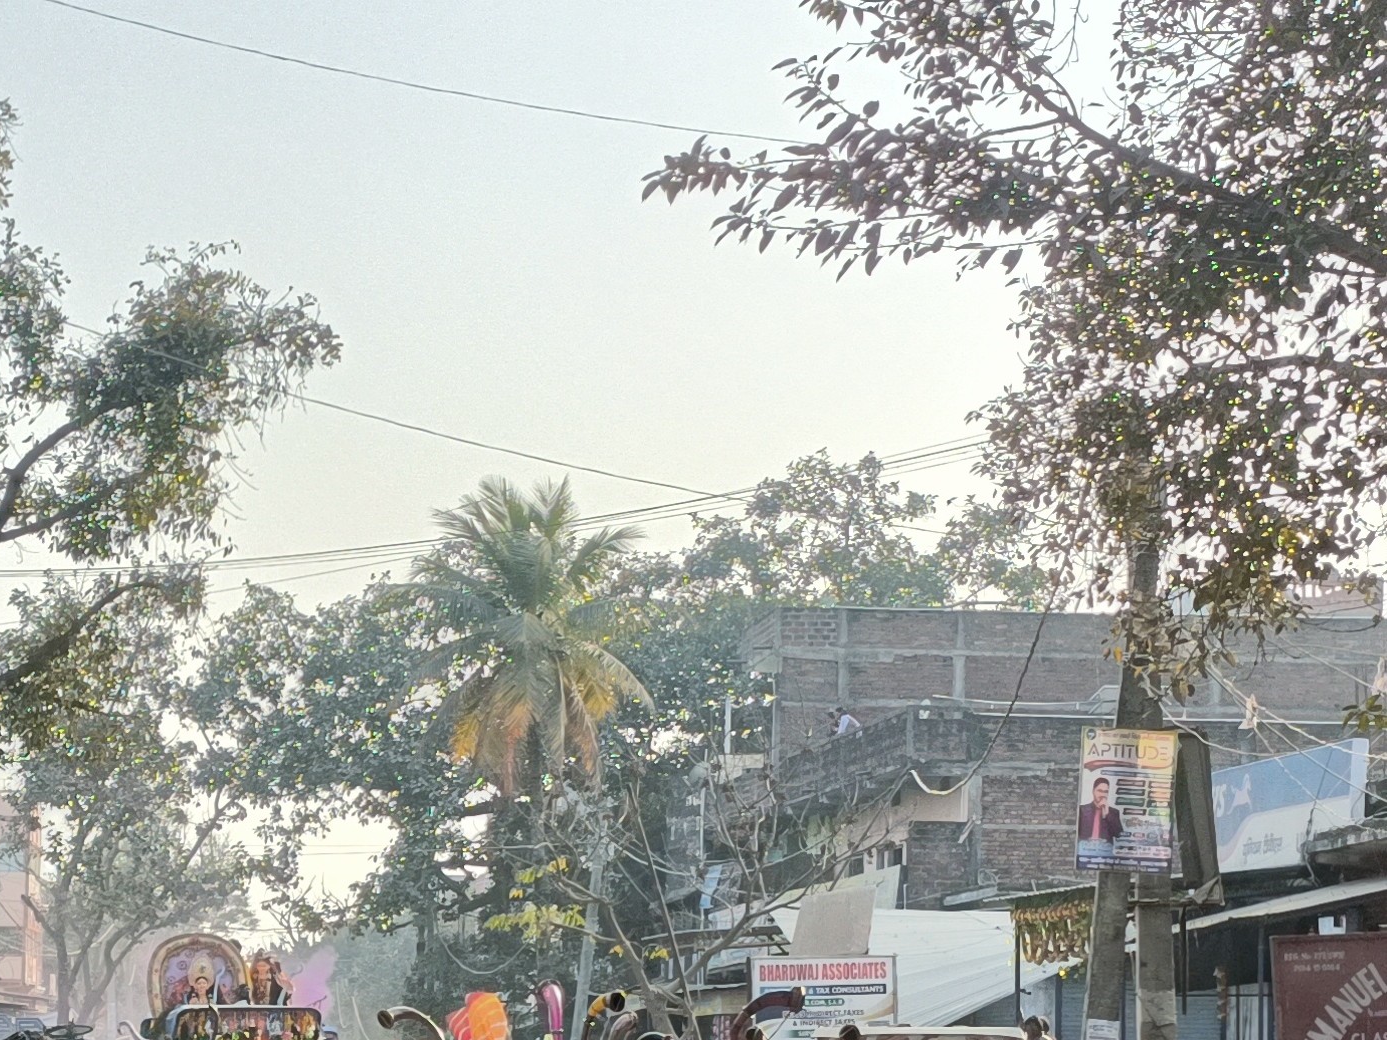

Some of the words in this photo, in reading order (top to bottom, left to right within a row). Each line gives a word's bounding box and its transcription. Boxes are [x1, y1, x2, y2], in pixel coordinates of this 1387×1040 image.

[1088, 742, 1169, 761] APTITUDE
[759, 964, 819, 982] BHARDWAJ
[821, 962, 887, 980] ASSOCIATES
[831, 985, 884, 994] CONSULTANTS
